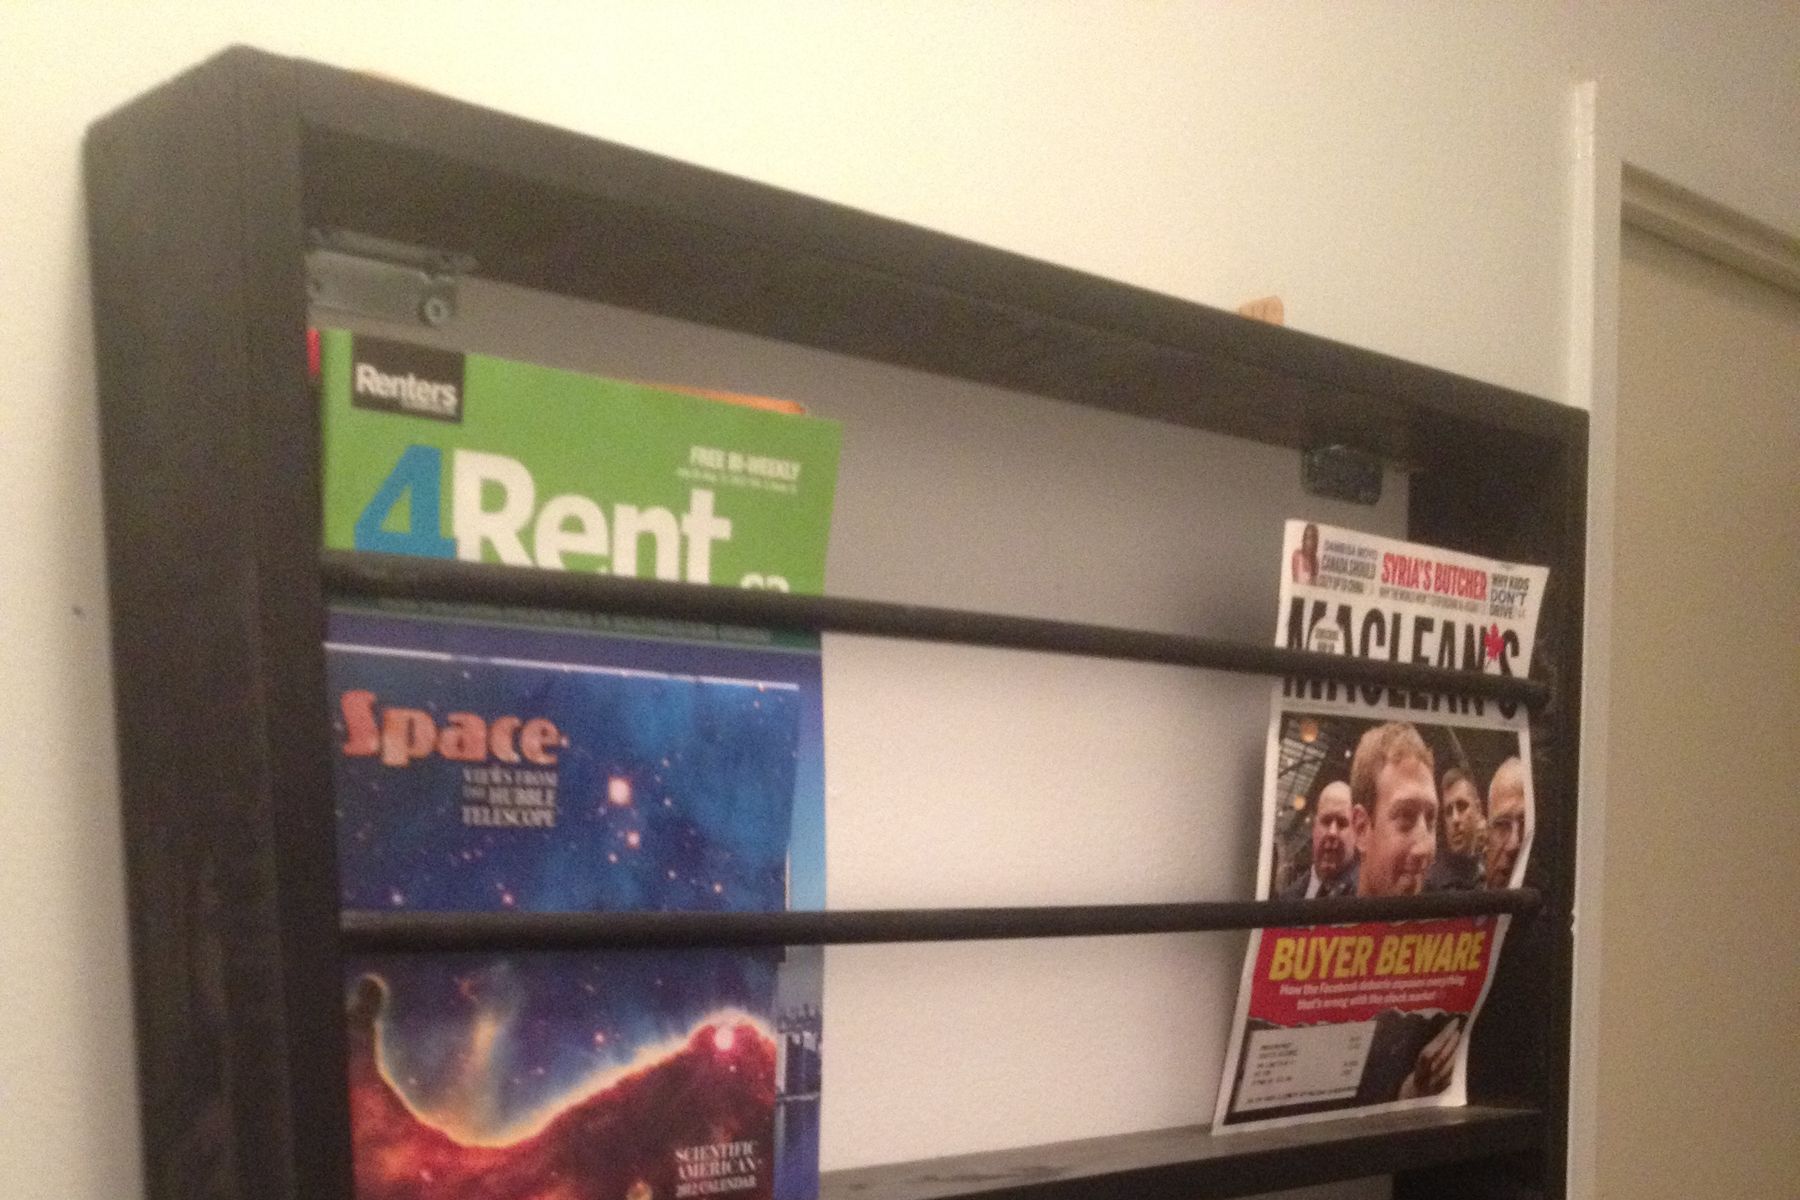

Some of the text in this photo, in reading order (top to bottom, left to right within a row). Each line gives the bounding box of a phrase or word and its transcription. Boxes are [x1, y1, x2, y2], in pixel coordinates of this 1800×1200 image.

[355, 362, 457, 410] Renters
[1381, 552, 1432, 591] SYRIA'S
[1434, 562, 1487, 601] BUTCHER
[1490, 590, 1527, 607] DON'T
[340, 690, 559, 766] Space
[1269, 931, 1486, 981] BUYER BEWARE
